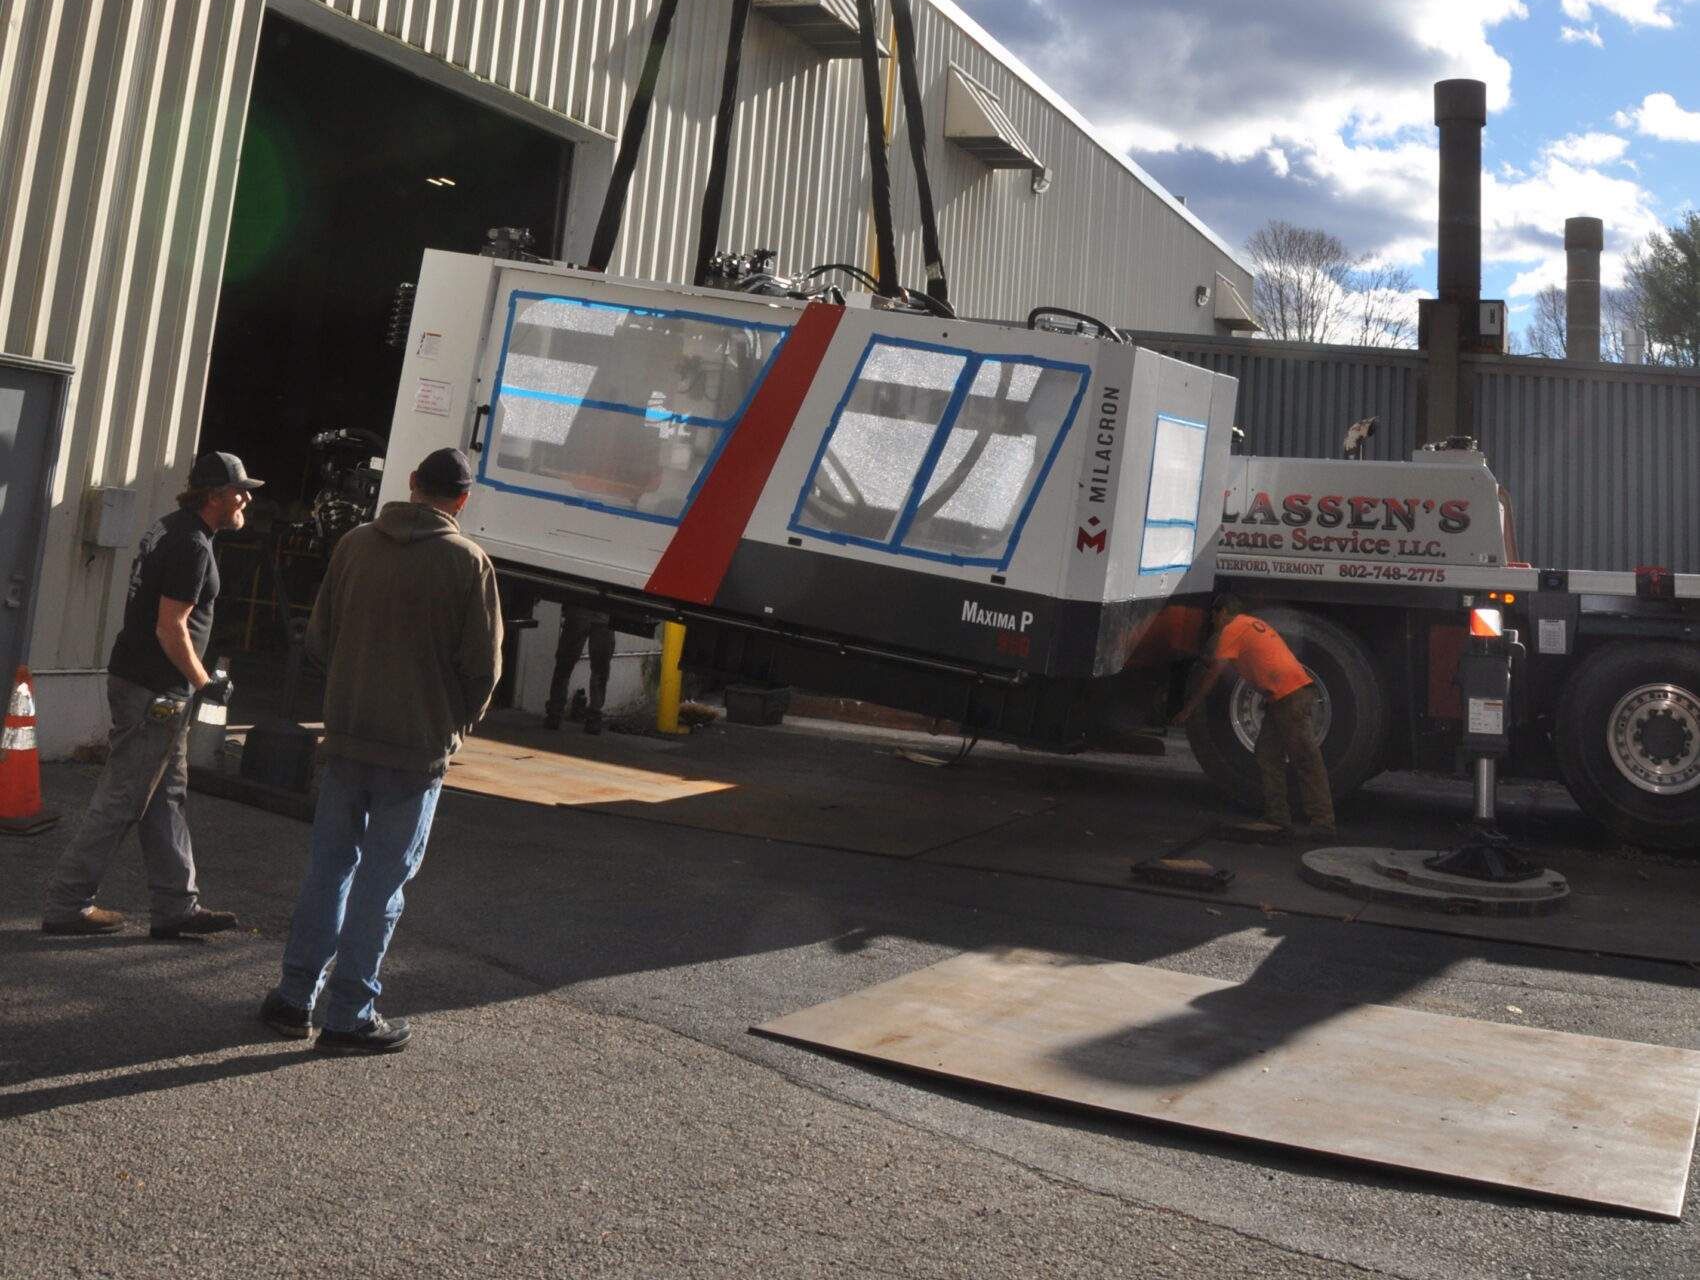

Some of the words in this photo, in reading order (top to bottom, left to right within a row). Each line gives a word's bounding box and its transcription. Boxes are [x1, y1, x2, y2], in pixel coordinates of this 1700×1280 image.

[1089, 386, 1120, 503] MILACRON
[1291, 527, 1391, 555] Service
[1398, 539, 1447, 558] LLC.
[1272, 561, 1325, 575] VERMONT
[1338, 563, 1446, 583] 802-748-2775
[1020, 610, 1034, 633] P
